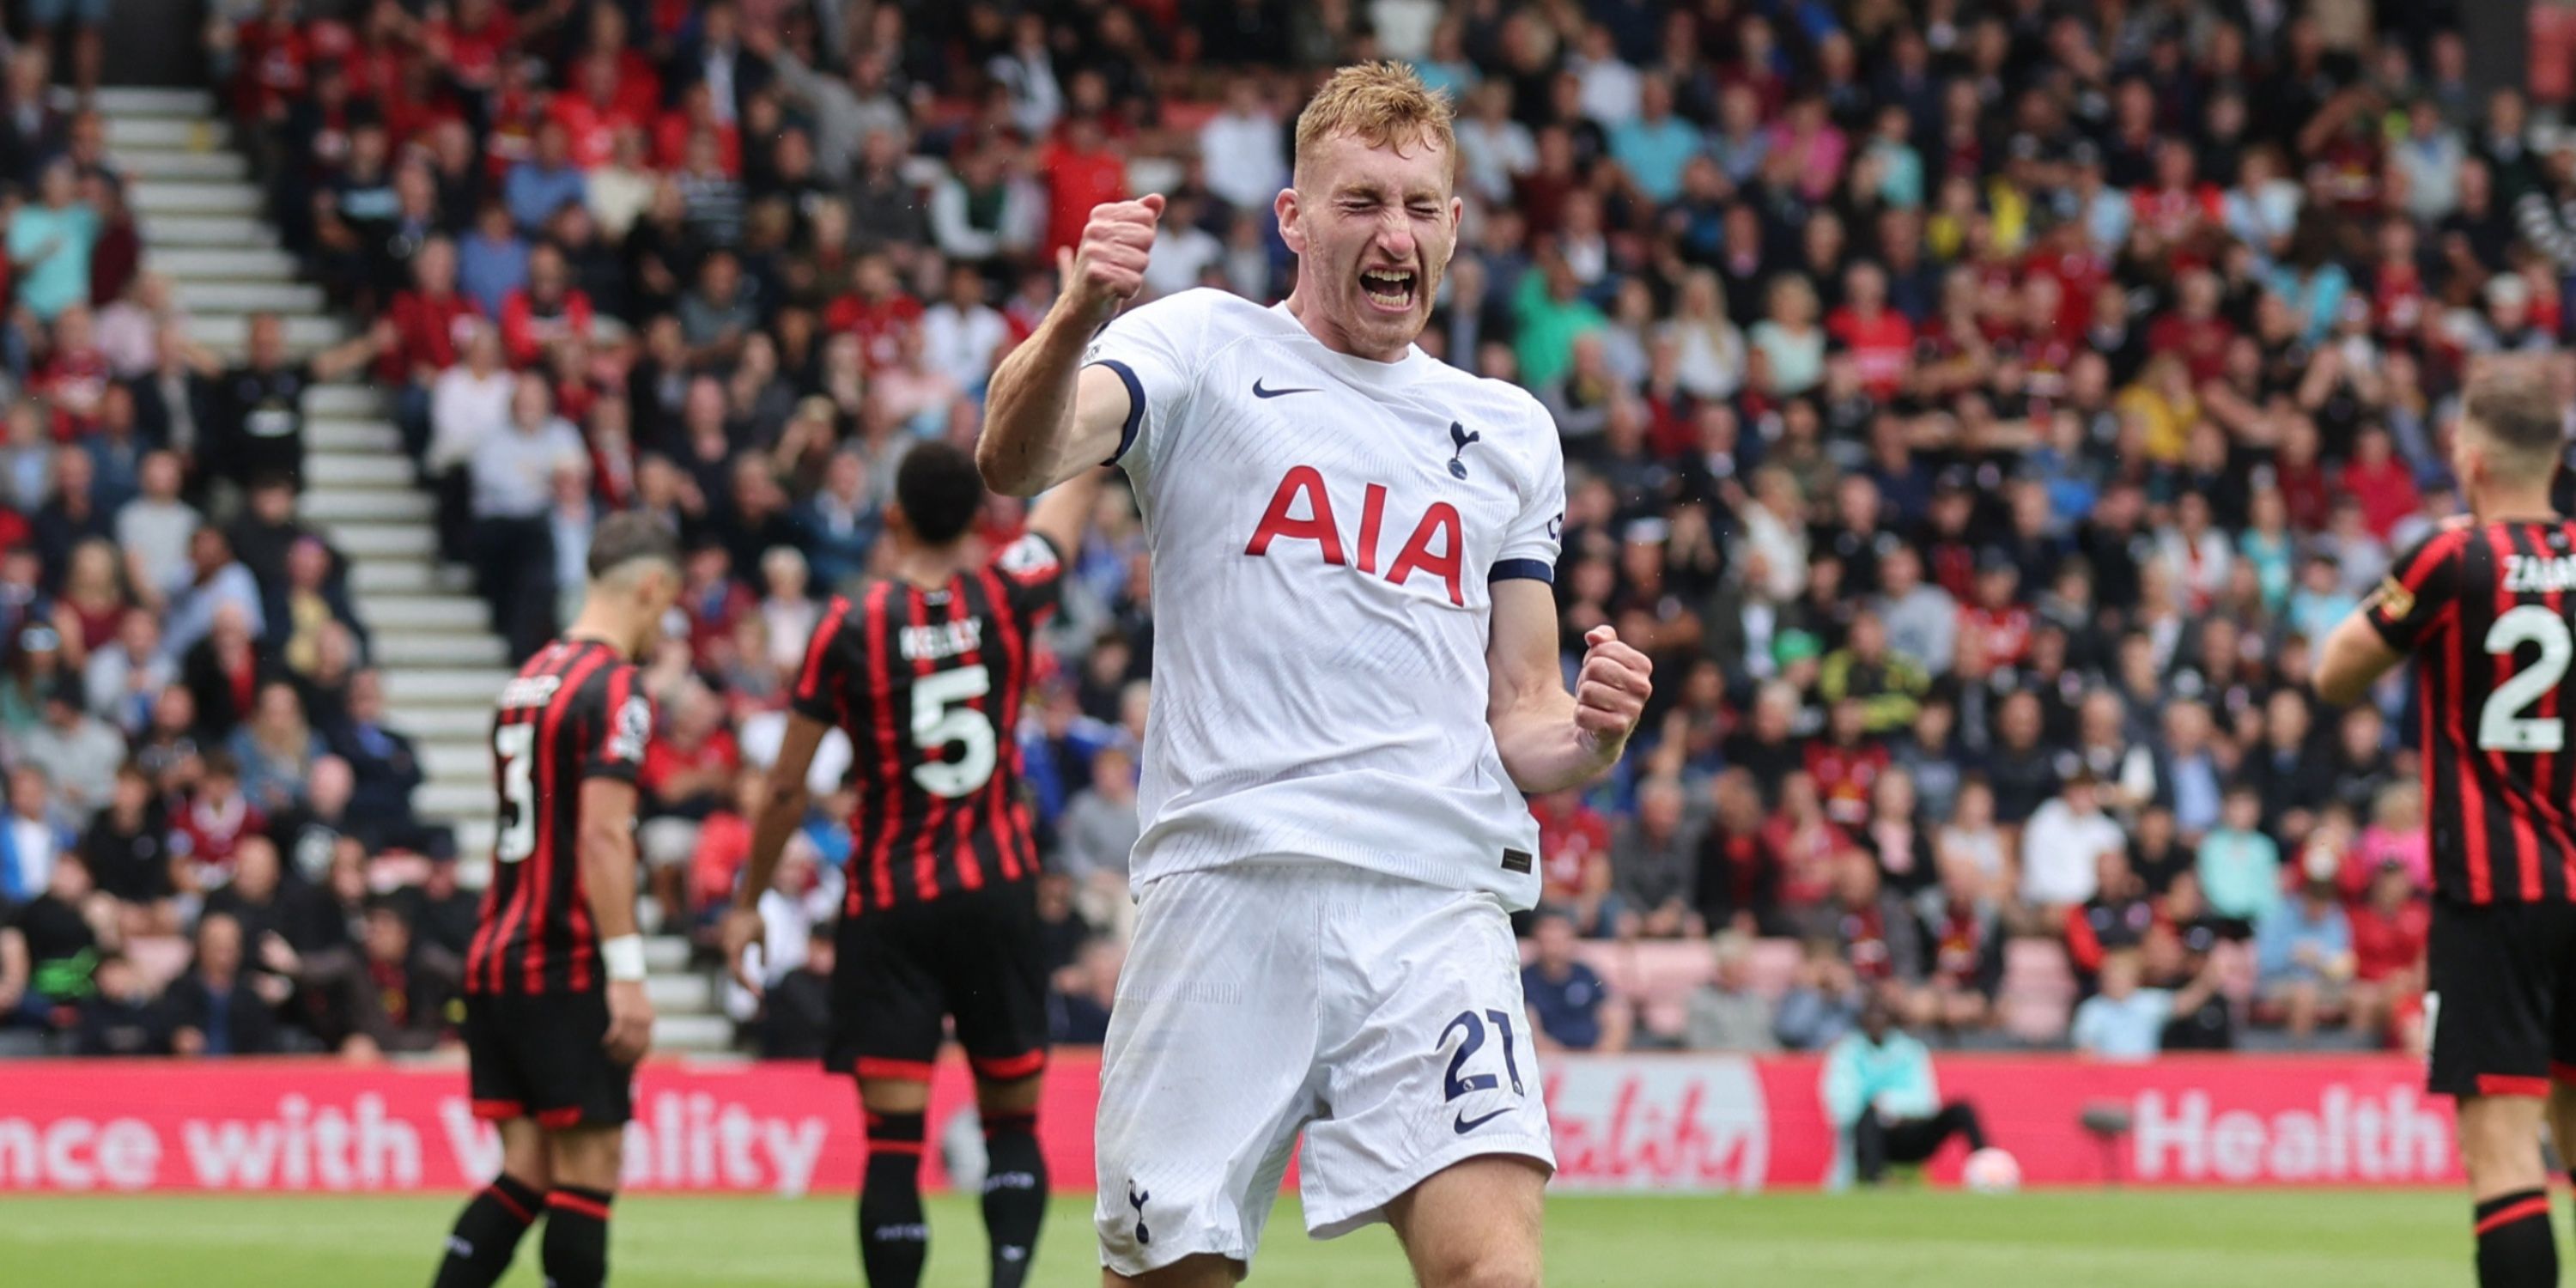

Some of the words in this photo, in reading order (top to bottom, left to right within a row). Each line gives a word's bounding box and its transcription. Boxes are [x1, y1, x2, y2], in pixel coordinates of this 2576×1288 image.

[1244, 465, 1464, 607] AIA
[911, 665, 997, 798] 5
[2478, 604, 2576, 752] 2
[495, 723, 535, 861] 3
[1436, 1008, 1525, 1103] 21
[183, 1092, 422, 1188] with
[437, 1091, 829, 1200] Vality
[2134, 1084, 2449, 1181] Health
